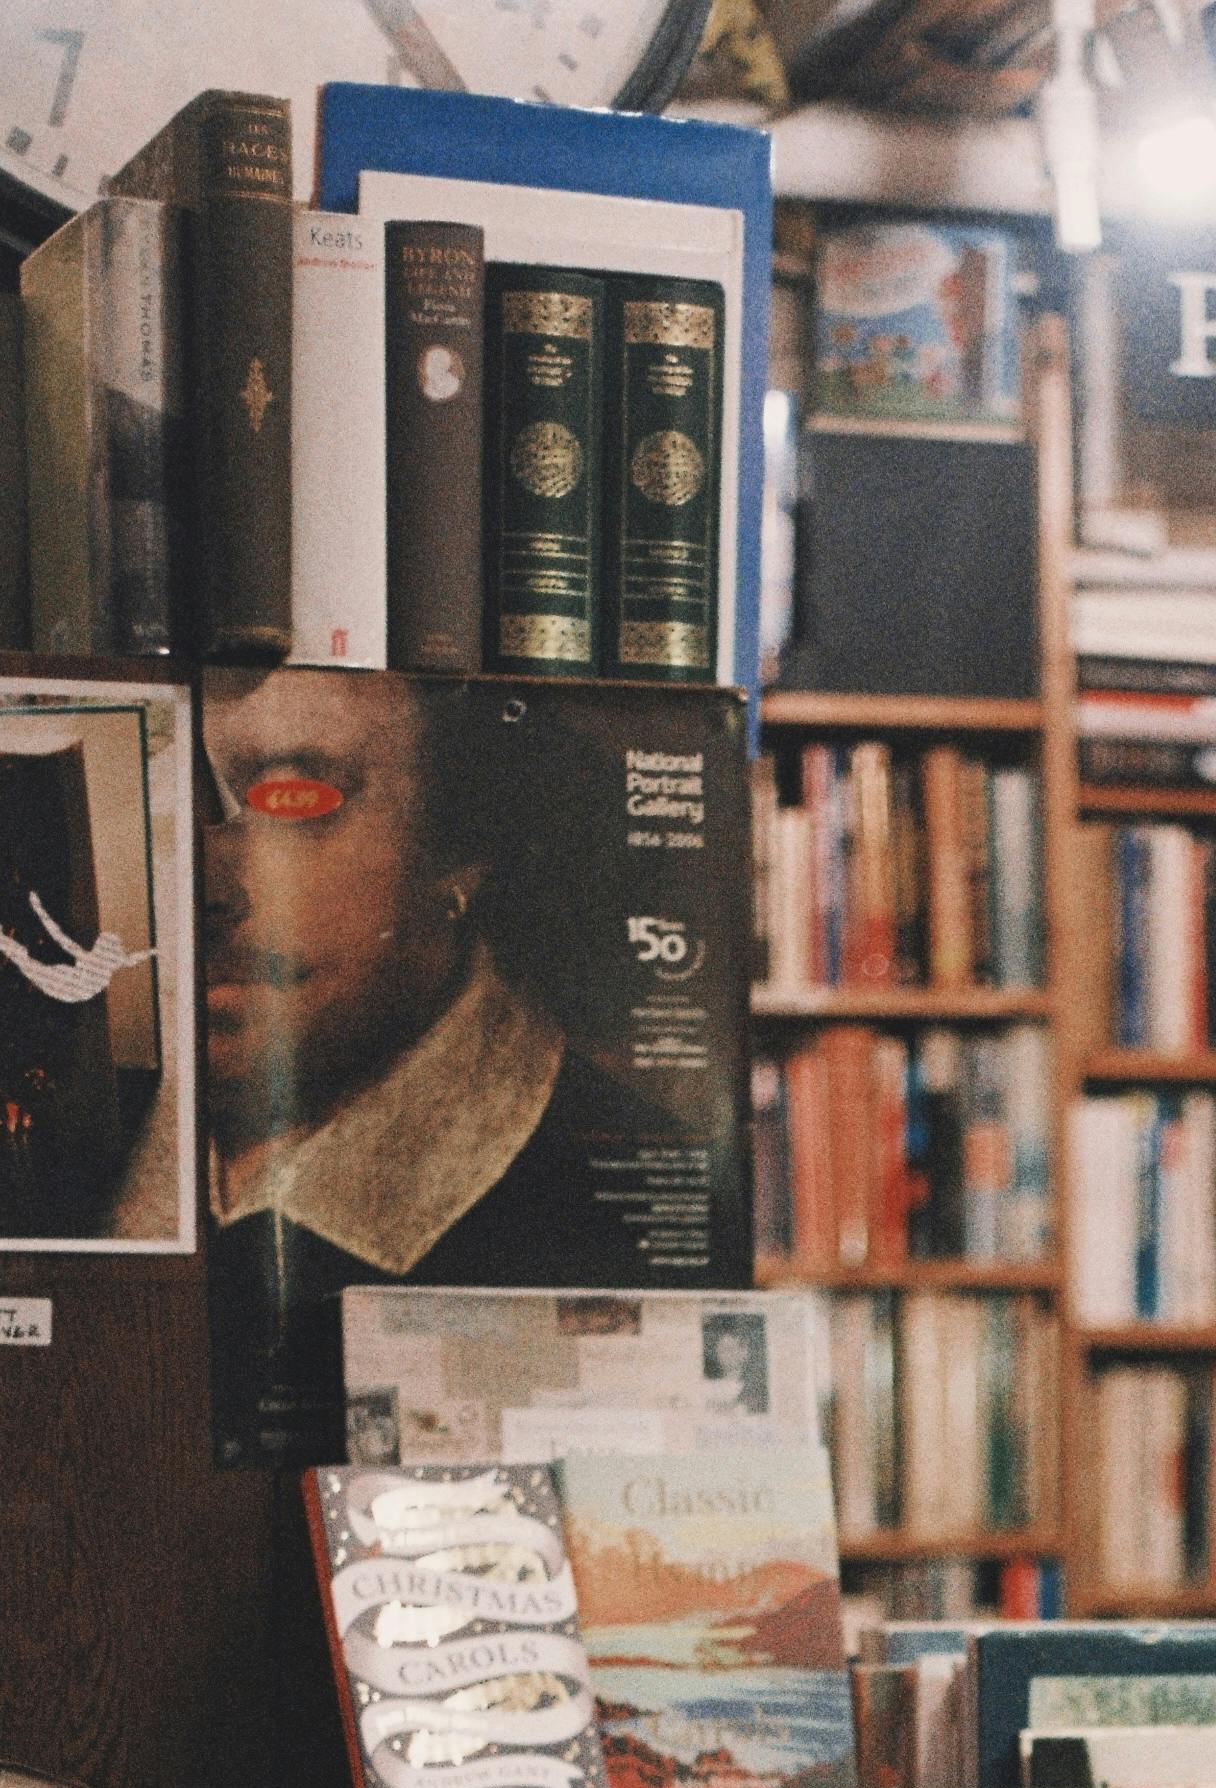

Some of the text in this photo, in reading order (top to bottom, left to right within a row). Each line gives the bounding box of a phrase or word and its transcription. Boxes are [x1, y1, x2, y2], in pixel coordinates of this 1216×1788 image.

[36, 29, 83, 126] 7
[309, 226, 363, 250] Keats
[402, 246, 475, 266] BYRON
[620, 1474, 775, 1518] Classic
[351, 1571, 564, 1615] CHRISTMAS
[396, 1640, 540, 1687] CAROLS
